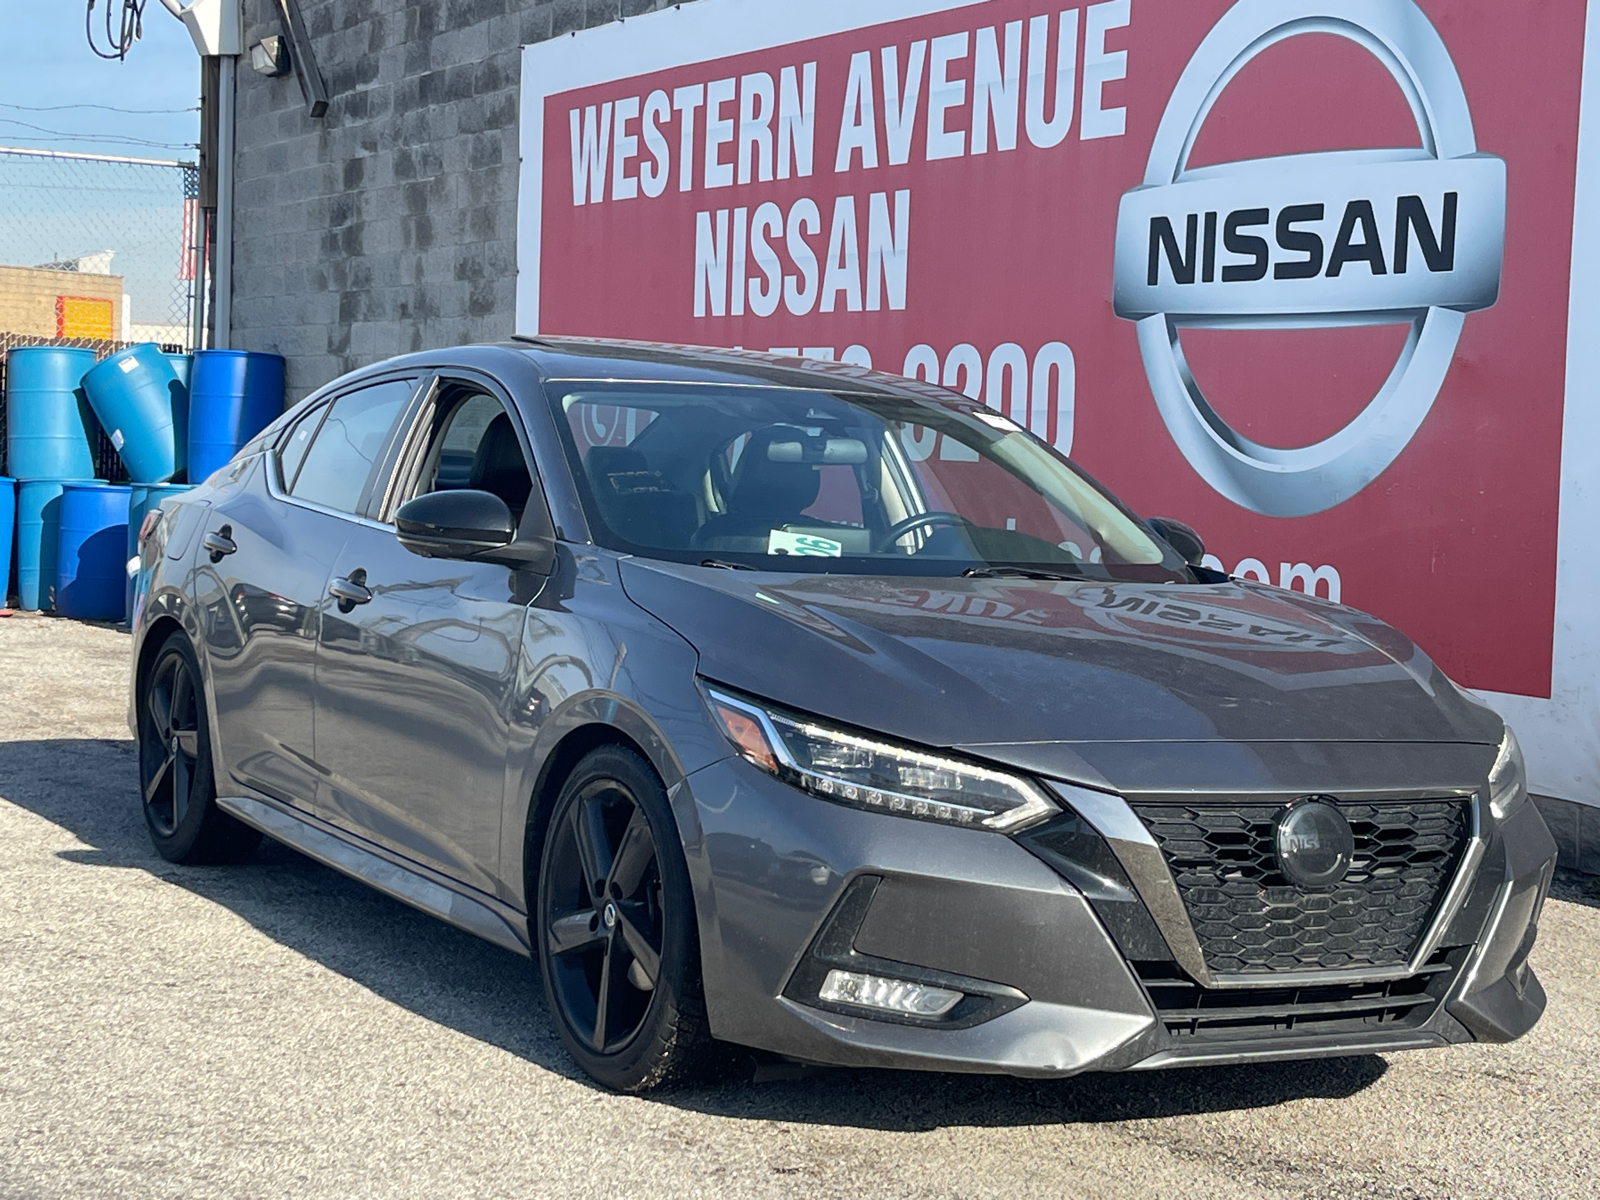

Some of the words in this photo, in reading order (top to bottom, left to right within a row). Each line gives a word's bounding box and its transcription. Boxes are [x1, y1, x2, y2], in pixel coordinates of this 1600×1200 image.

[569, 61, 817, 207] WESTERN
[834, 0, 1132, 173] AVENUE
[693, 189, 911, 318] NISSAN
[1147, 191, 1458, 286] NISSAN
